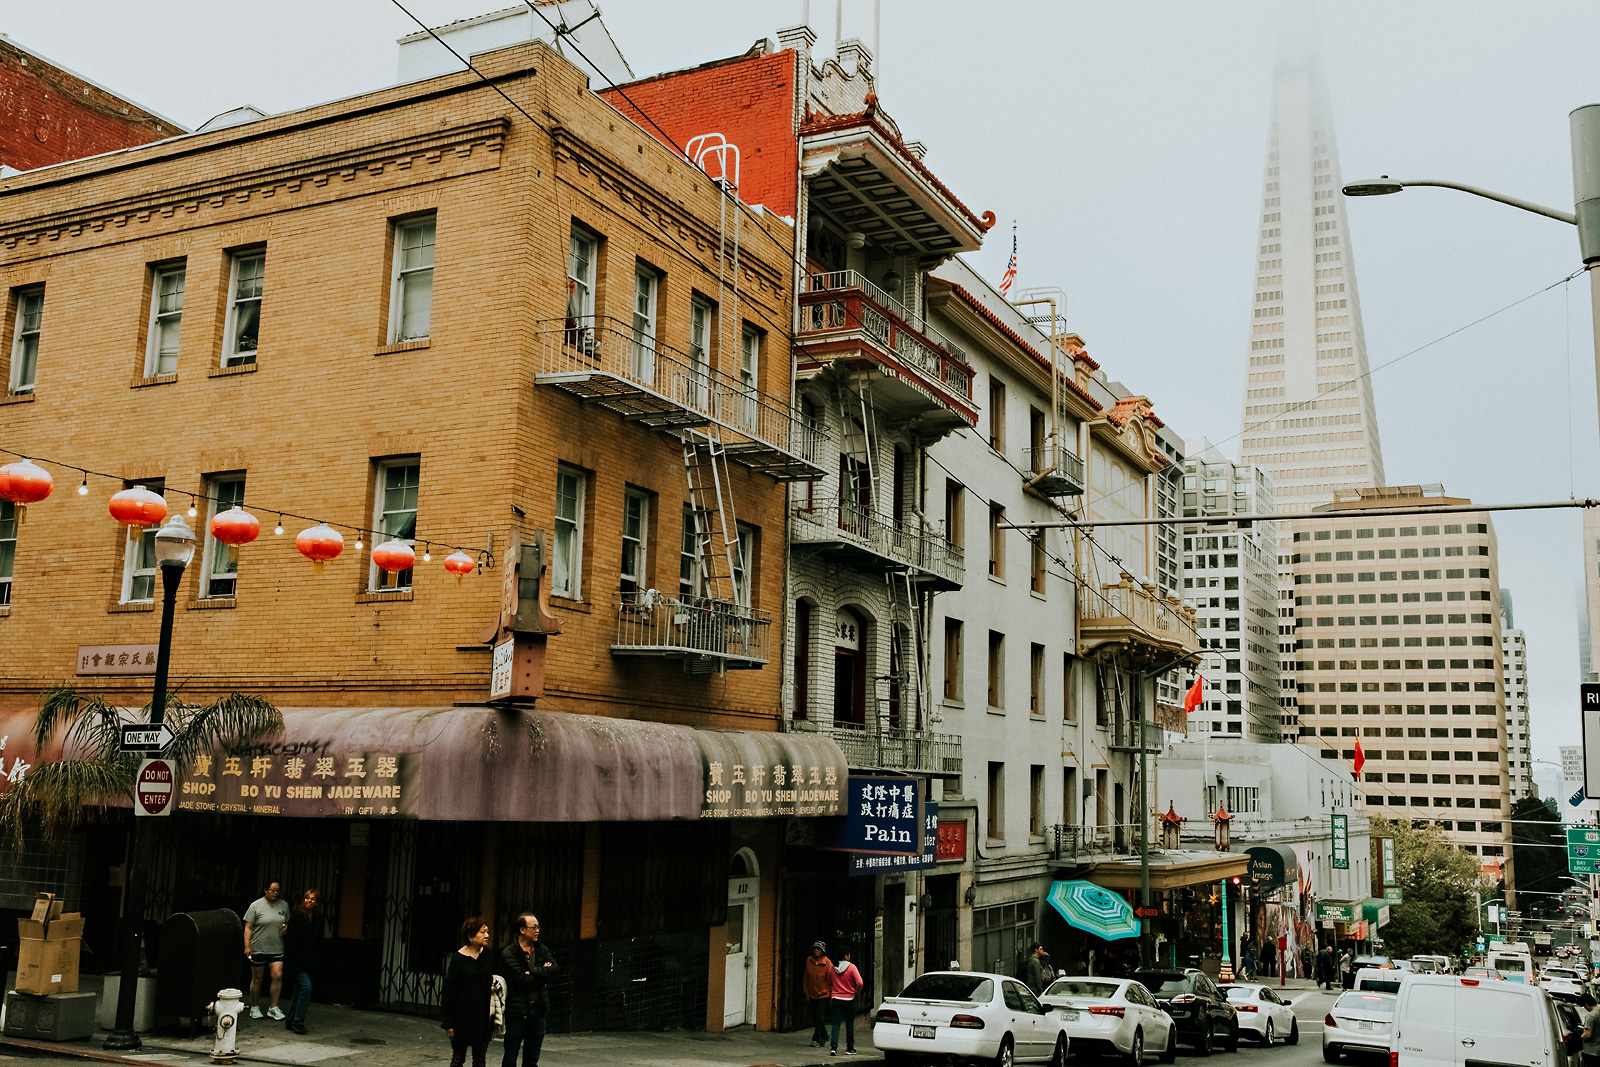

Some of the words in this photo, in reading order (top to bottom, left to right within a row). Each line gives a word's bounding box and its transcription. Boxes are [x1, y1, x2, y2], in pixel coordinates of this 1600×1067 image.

[126, 732, 142, 744] ONE
[144, 732, 161, 743] WAY
[145, 770, 156, 780] DO
[156, 770, 170, 781] NOT
[182, 781, 217, 796] SHOP
[240, 784, 259, 798] BO
[264, 785, 282, 799] YU
[286, 785, 323, 799] SHEM
[327, 785, 401, 799] JADEWARE
[706, 789, 732, 804] SHOP
[745, 789, 758, 804] BO
[761, 789, 773, 803] YU
[775, 789, 797, 803] SHEM
[799, 789, 839, 803] JADEWARE
[861, 783, 915, 803] 建隆中醫
[144, 794, 167, 805] ENTER
[178, 801, 194, 811] JADE
[195, 801, 216, 811] STONE
[220, 803, 248, 812] CRYSTAL
[253, 805, 281, 814] MINERAL
[358, 806, 374, 815] GIFT
[700, 809, 712, 818] JADE
[713, 809, 729, 818] STONE
[733, 808, 752, 817] CRYSTAL
[777, 806, 794, 816] FOSSILS
[799, 805, 817, 815] JEWELRY
[817, 805, 827, 814] GIFT
[860, 801, 915, 820] 跌打痛症
[864, 824, 912, 843] Pain
[1252, 860, 1272, 869] Asian
[1252, 870, 1273, 881] Image
